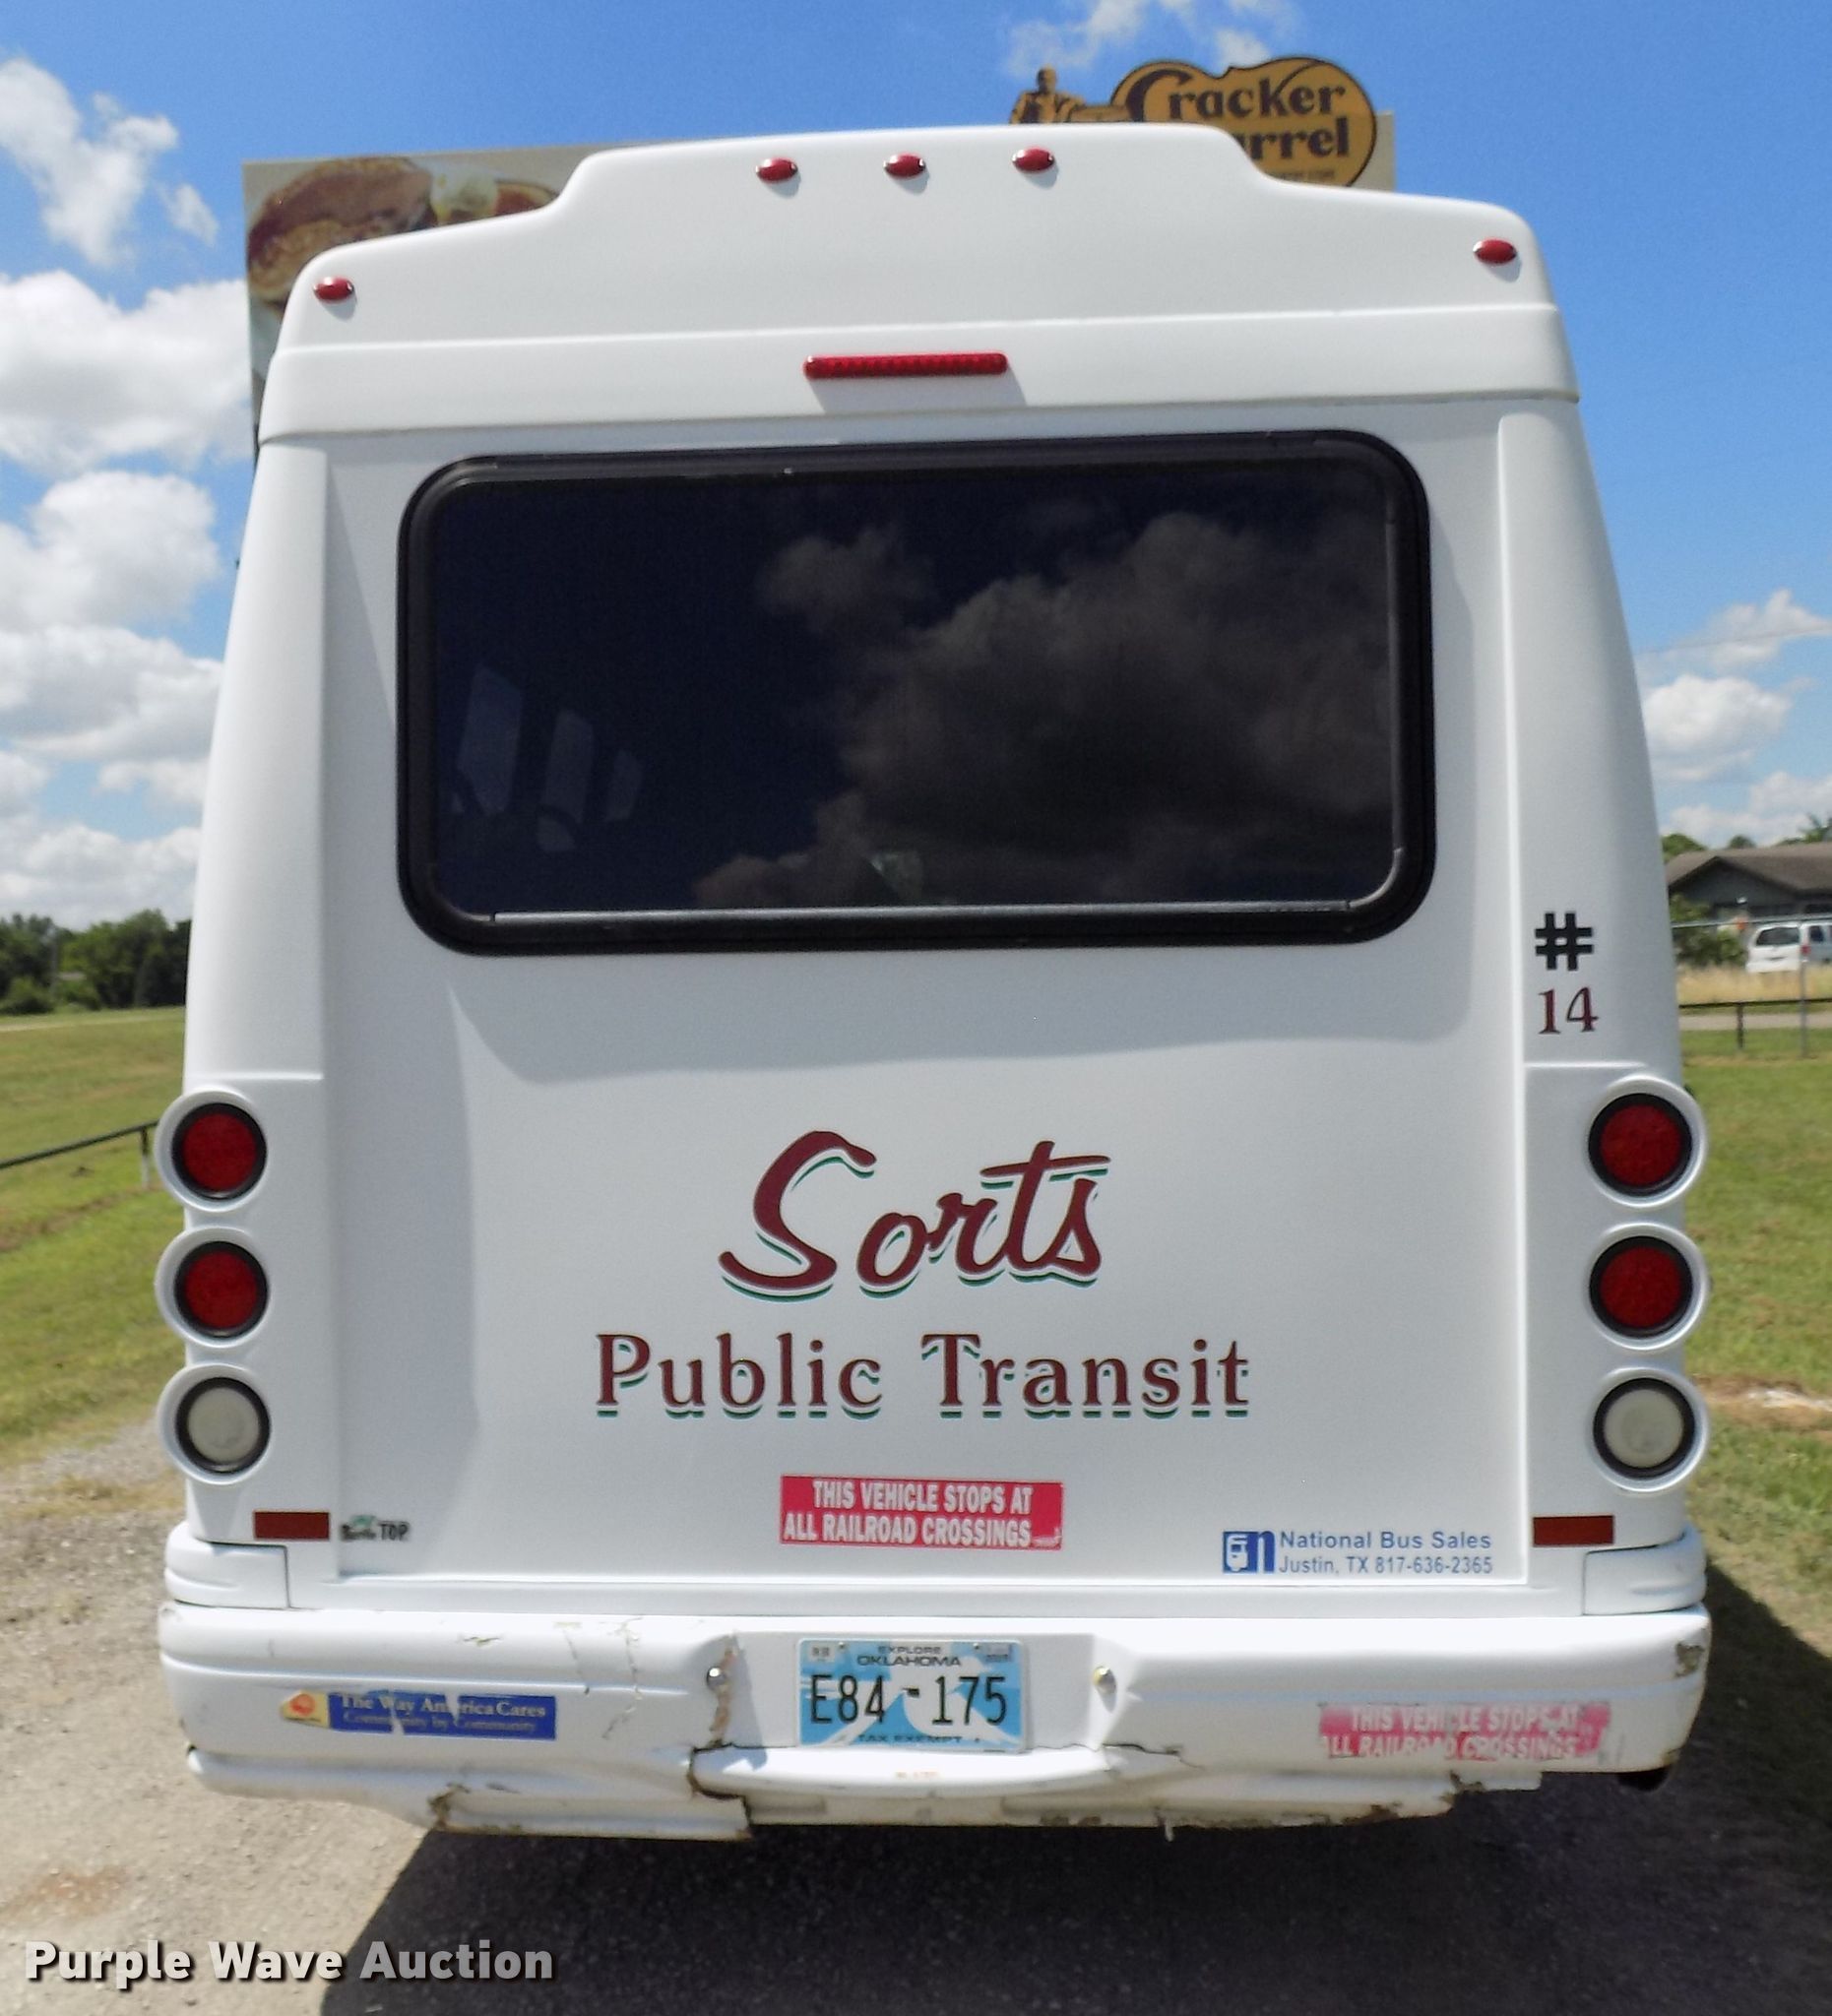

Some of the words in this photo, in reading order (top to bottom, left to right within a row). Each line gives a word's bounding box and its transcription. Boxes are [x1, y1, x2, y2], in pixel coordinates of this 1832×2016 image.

[1125, 69, 1346, 122] Cracker
[1535, 913, 1593, 971] #
[1538, 986, 1600, 1035] 14
[718, 1130, 1111, 1300] Sorts
[596, 1332, 883, 1418] Public
[920, 1332, 1248, 1418] Transit
[813, 1480, 854, 1509] THIS
[860, 1482, 938, 1512] VEHICLE
[944, 1484, 1005, 1514] STOPS
[1010, 1486, 1033, 1515] AT
[784, 1512, 818, 1541] ALL
[823, 1513, 916, 1544] RAILROAD
[922, 1517, 1031, 1547] CROSSINGS
[1280, 1531, 1371, 1549] National
[1381, 1532, 1423, 1549] Bus
[1431, 1532, 1491, 1549] Sales
[1280, 1555, 1340, 1575] Justin,
[1347, 1556, 1373, 1573] TX
[1375, 1556, 1493, 1574] 817-636-2365
[857, 1656, 962, 1667] OKLAHOMA
[877, 1646, 942, 1655] EXPLORE
[496, 1701, 546, 1717] Cares
[810, 1674, 885, 1724] E84
[931, 1675, 1007, 1726] 175
